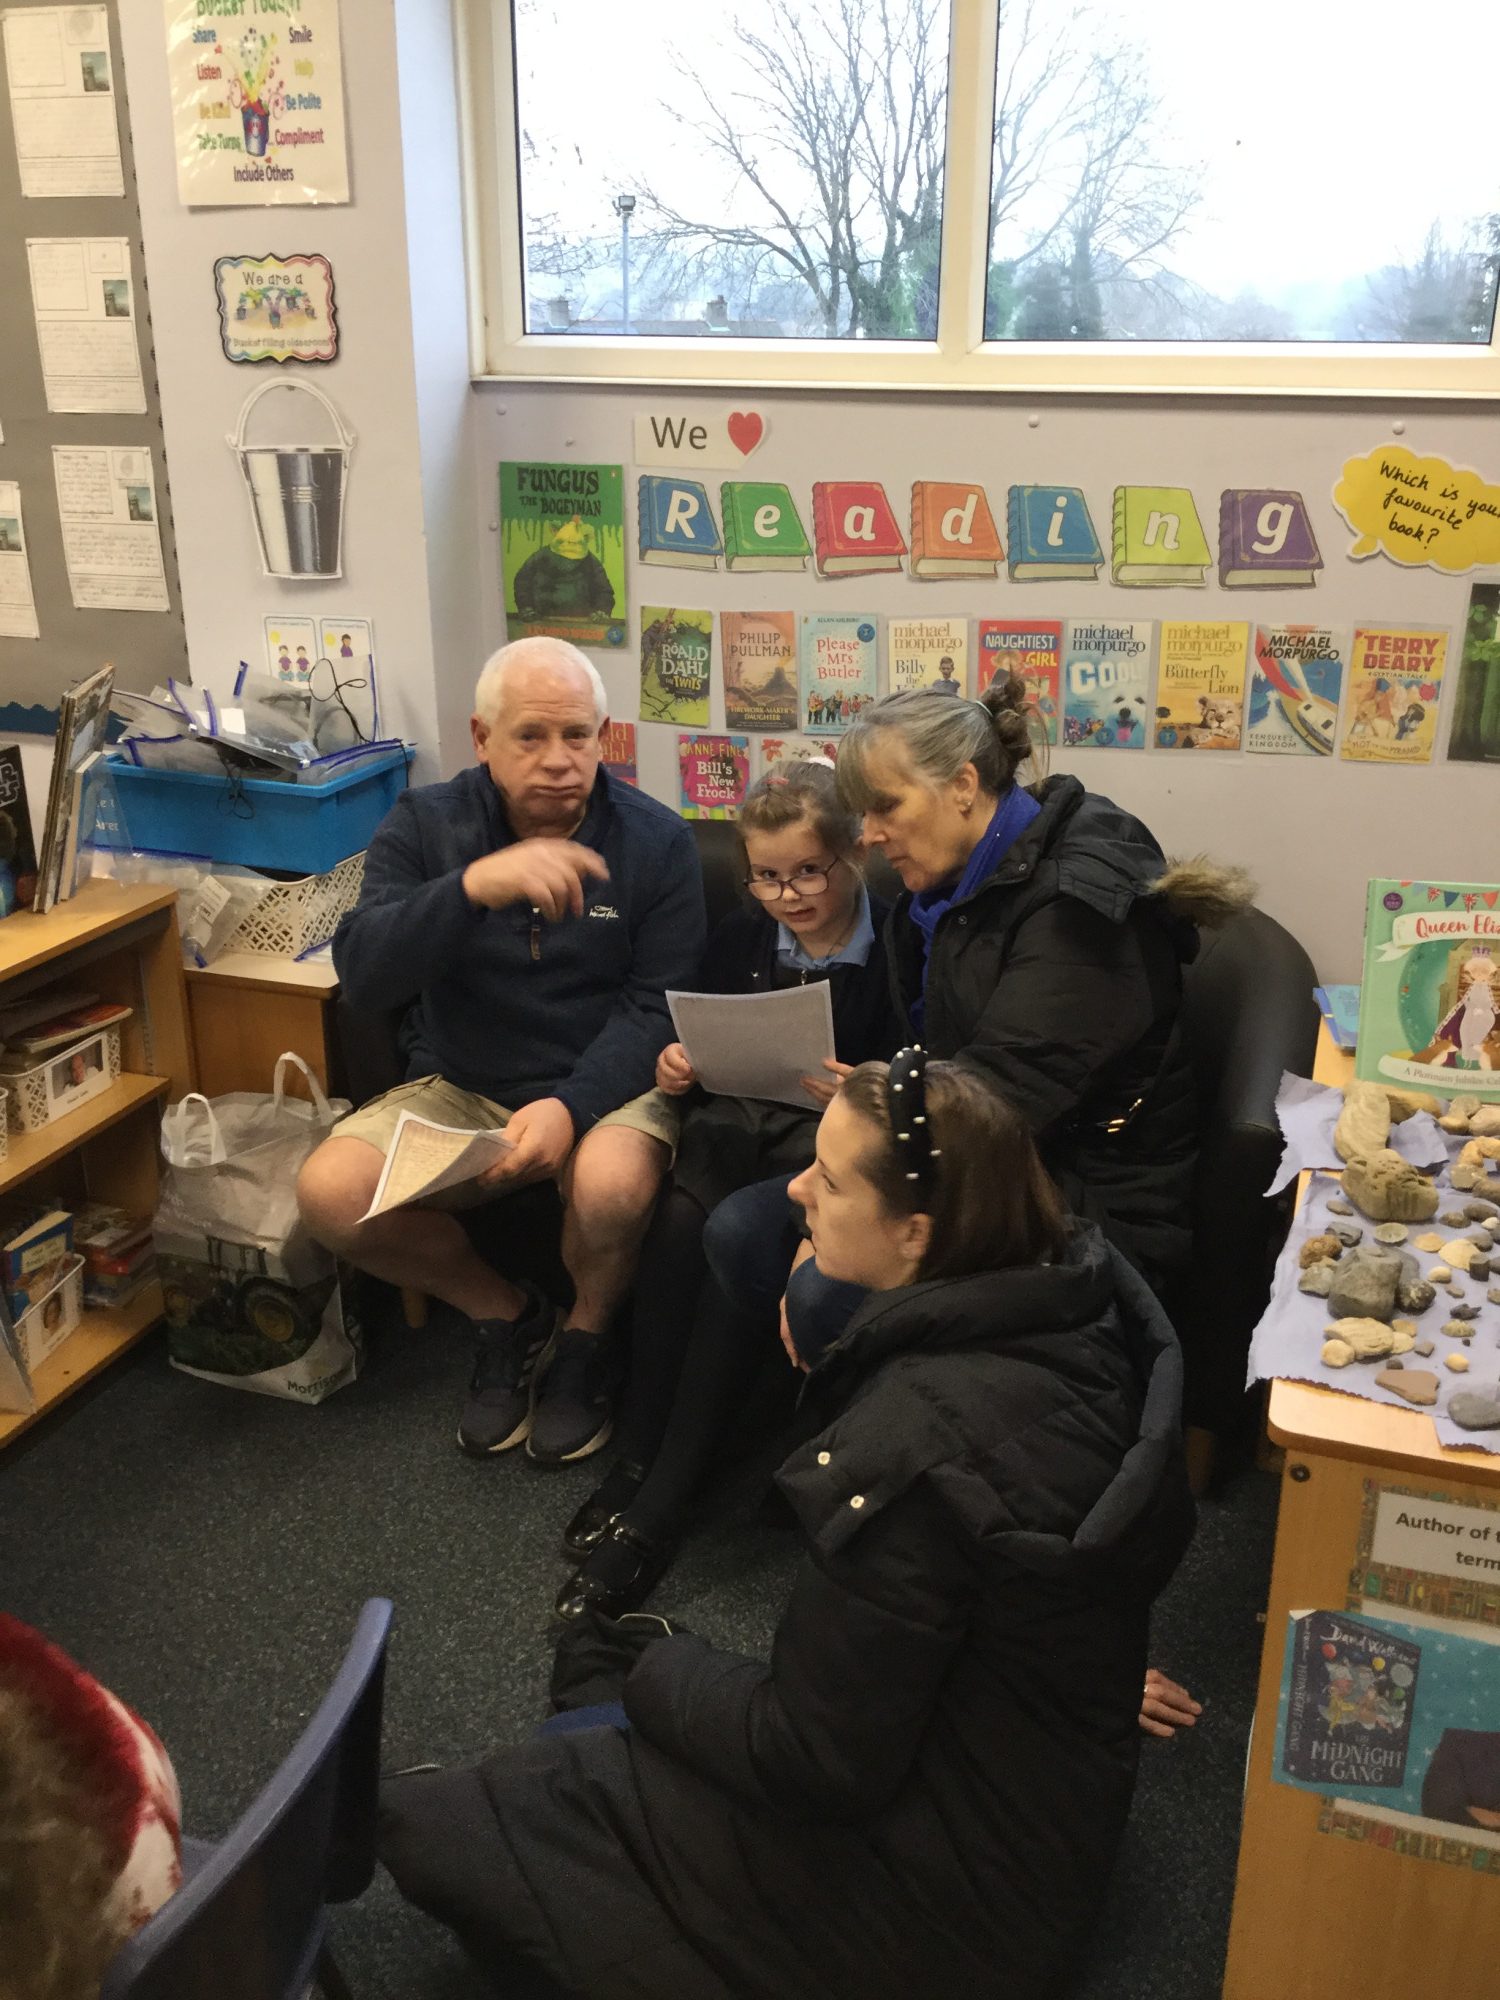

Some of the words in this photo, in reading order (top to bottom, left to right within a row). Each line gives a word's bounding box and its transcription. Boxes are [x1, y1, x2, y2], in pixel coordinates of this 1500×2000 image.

[289, 25, 312, 43] Smile
[197, 64, 221, 80] Listen
[286, 94, 296, 110] Be
[298, 92, 321, 110] Polite
[275, 127, 324, 147] Compliment
[234, 166, 264, 182] Include
[265, 166, 294, 181] Others
[243, 271, 263, 285] We
[268, 274, 290, 285] are
[650, 416, 707, 450] We
[517, 467, 600, 496] FUNGUS
[1380, 460, 1429, 491] Which
[1440, 483, 1459, 500] is
[541, 498, 601, 517] BOGEYMAN
[1383, 488, 1464, 530] favourite
[1388, 512, 1440, 550] book?
[739, 632, 781, 644] PHILIP
[894, 622, 950, 638] michael
[1073, 624, 1134, 641] michael
[1167, 624, 1231, 640] michael
[816, 637, 860, 652] Please
[894, 637, 963, 653] morpurgo
[985, 634, 1055, 650] NAUGHTIEST
[1072, 640, 1147, 657] morpurgo
[1167, 641, 1243, 658] morpurgo
[1268, 635, 1332, 649] MICHAEL
[1363, 635, 1440, 655] TERRY
[661, 642, 709, 661] ROALD
[730, 645, 792, 657] PULLMAN
[827, 653, 854, 665] Mrs
[1025, 651, 1058, 667] GIRL
[1258, 647, 1340, 661] MORPURGO
[661, 658, 708, 679] DAHL
[896, 659, 927, 675] Billy
[1362, 653, 1437, 673] DEARY
[817, 665, 862, 680] Butler
[1165, 664, 1229, 680] Butterfly
[673, 675, 702, 691] TWITS
[1208, 679, 1240, 694] Lion
[744, 712, 781, 721] DAUGHTER
[1249, 741, 1297, 749] KINGDOM
[696, 760, 733, 774] Bill's
[709, 775, 734, 787] New
[696, 783, 735, 799] Frock
[1415, 916, 1469, 939] Queen
[1404, 1067, 1411, 1076] A
[1395, 1512, 1464, 1536] Author
[1469, 1526, 1491, 1541] of
[1456, 1551, 1500, 1571] term
[1330, 1760, 1384, 1784] GANG
